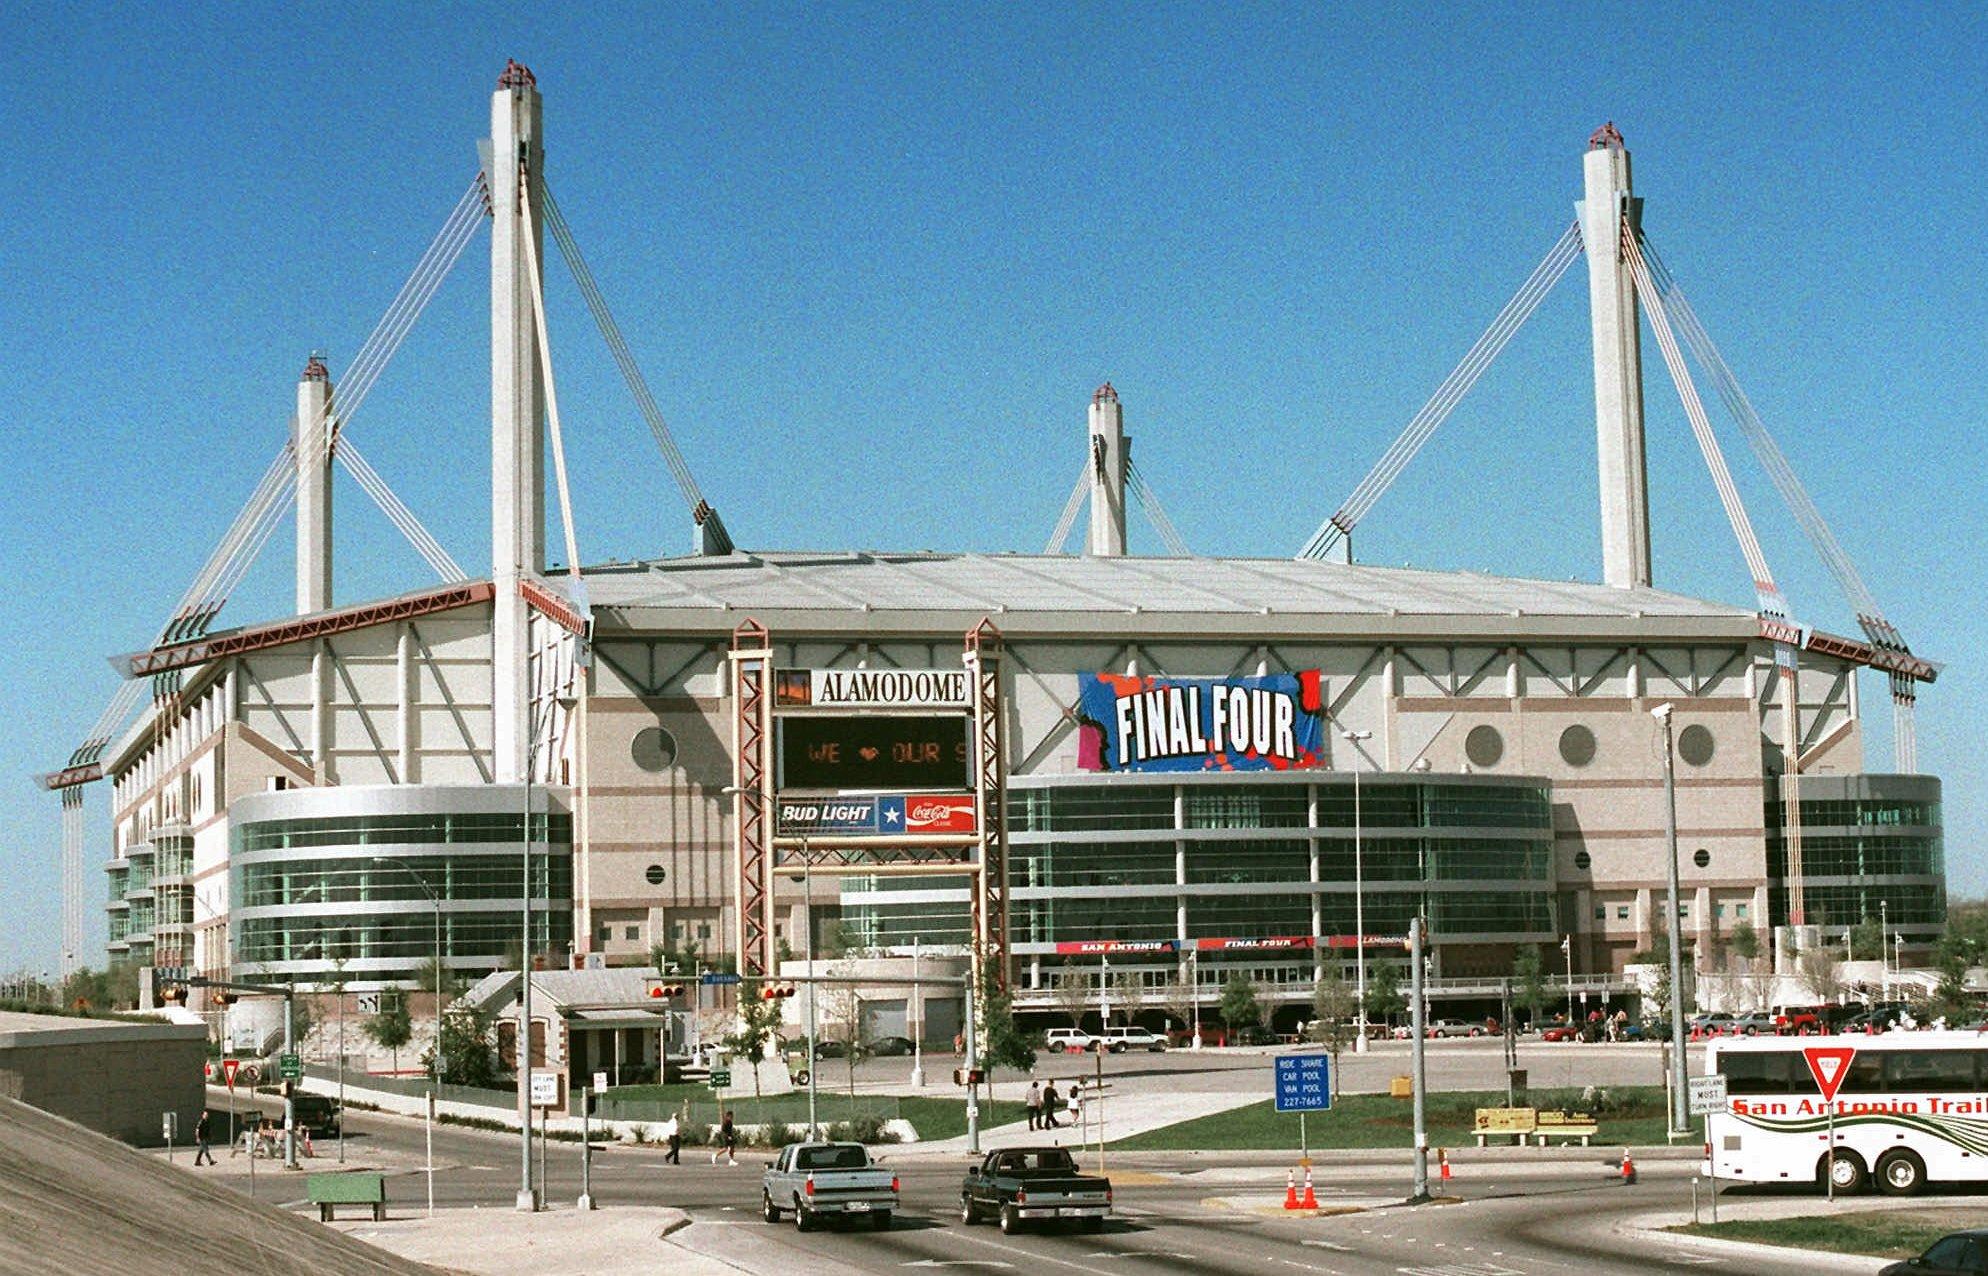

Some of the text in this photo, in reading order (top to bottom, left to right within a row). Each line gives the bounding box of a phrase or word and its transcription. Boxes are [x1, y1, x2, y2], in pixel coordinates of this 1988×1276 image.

[819, 673, 966, 702] ALAMODOME
[1115, 684, 1295, 764] FINAL FOUR
[807, 743, 840, 763] WE
[892, 742, 941, 763] OUR
[781, 804, 872, 820] BUD LIGHT
[912, 804, 951, 820] Coca-Cola
[1108, 942, 1162, 951] ANTONIO
[1224, 939, 1292, 948] FINAL FOUR
[1279, 1058, 1324, 1069] RIDE SHARE
[1282, 1071, 1321, 1081] CAR POOL
[1283, 1083, 1321, 1093] VAN POOL
[1697, 1090, 1718, 1099] MUST
[1284, 1096, 1323, 1107] 227-7665
[1733, 1098, 1787, 1115] San
[1796, 1098, 1918, 1116] Antonio
